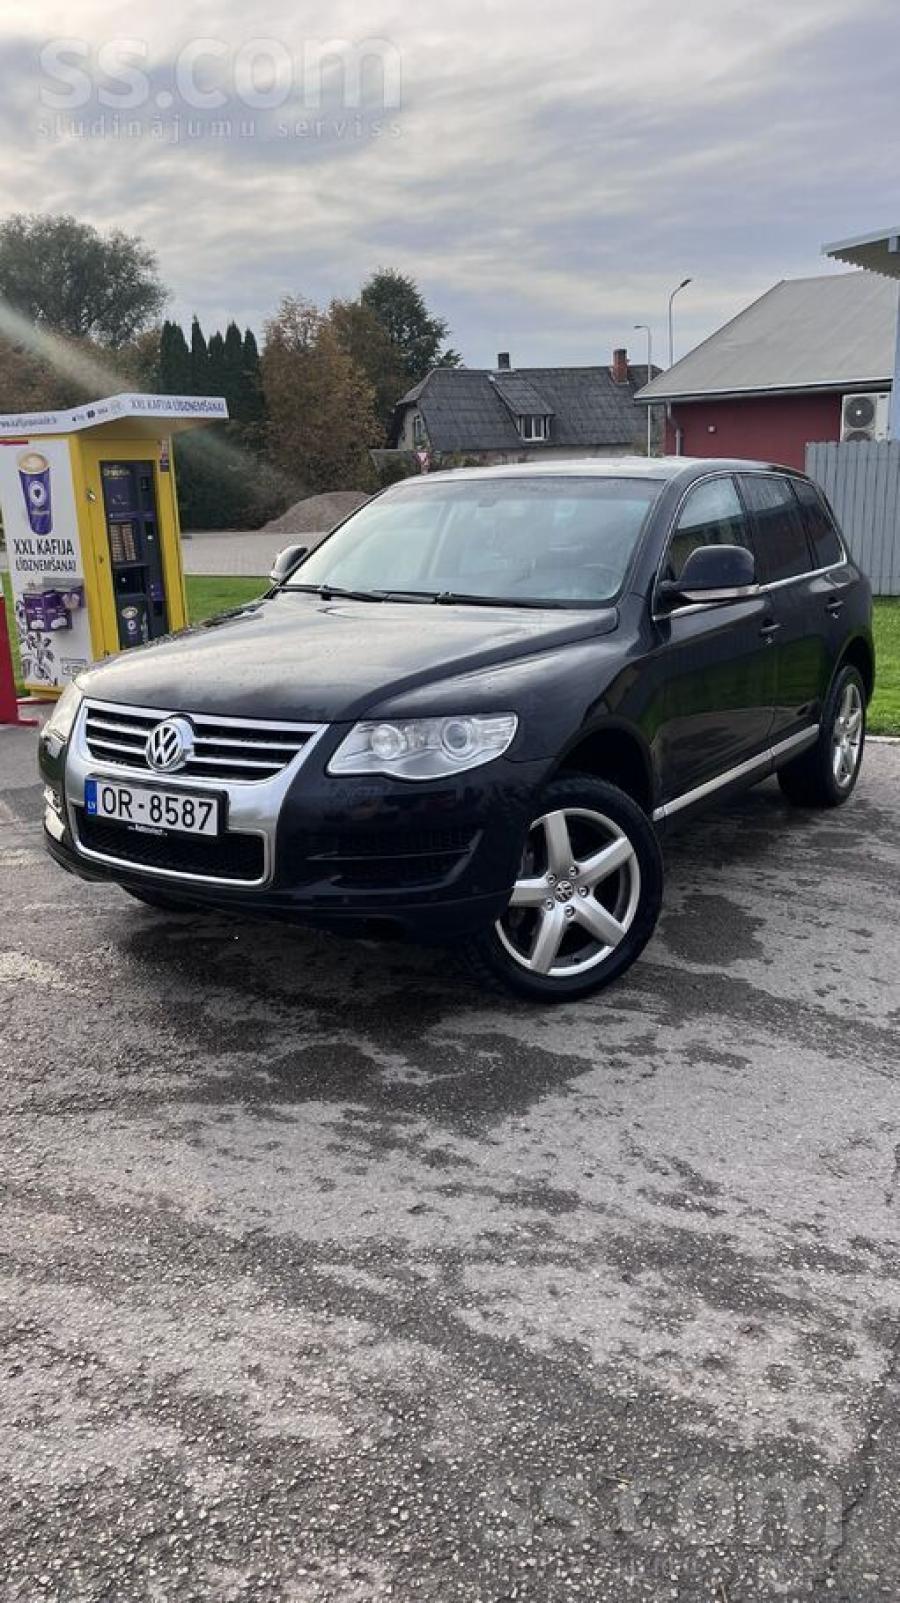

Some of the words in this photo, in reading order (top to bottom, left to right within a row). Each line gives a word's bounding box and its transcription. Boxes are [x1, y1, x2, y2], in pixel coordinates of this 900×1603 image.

[12, 539, 36, 555] XXL
[37, 538, 75, 556] KAFIJA
[102, 787, 213, 831] OR-8587
